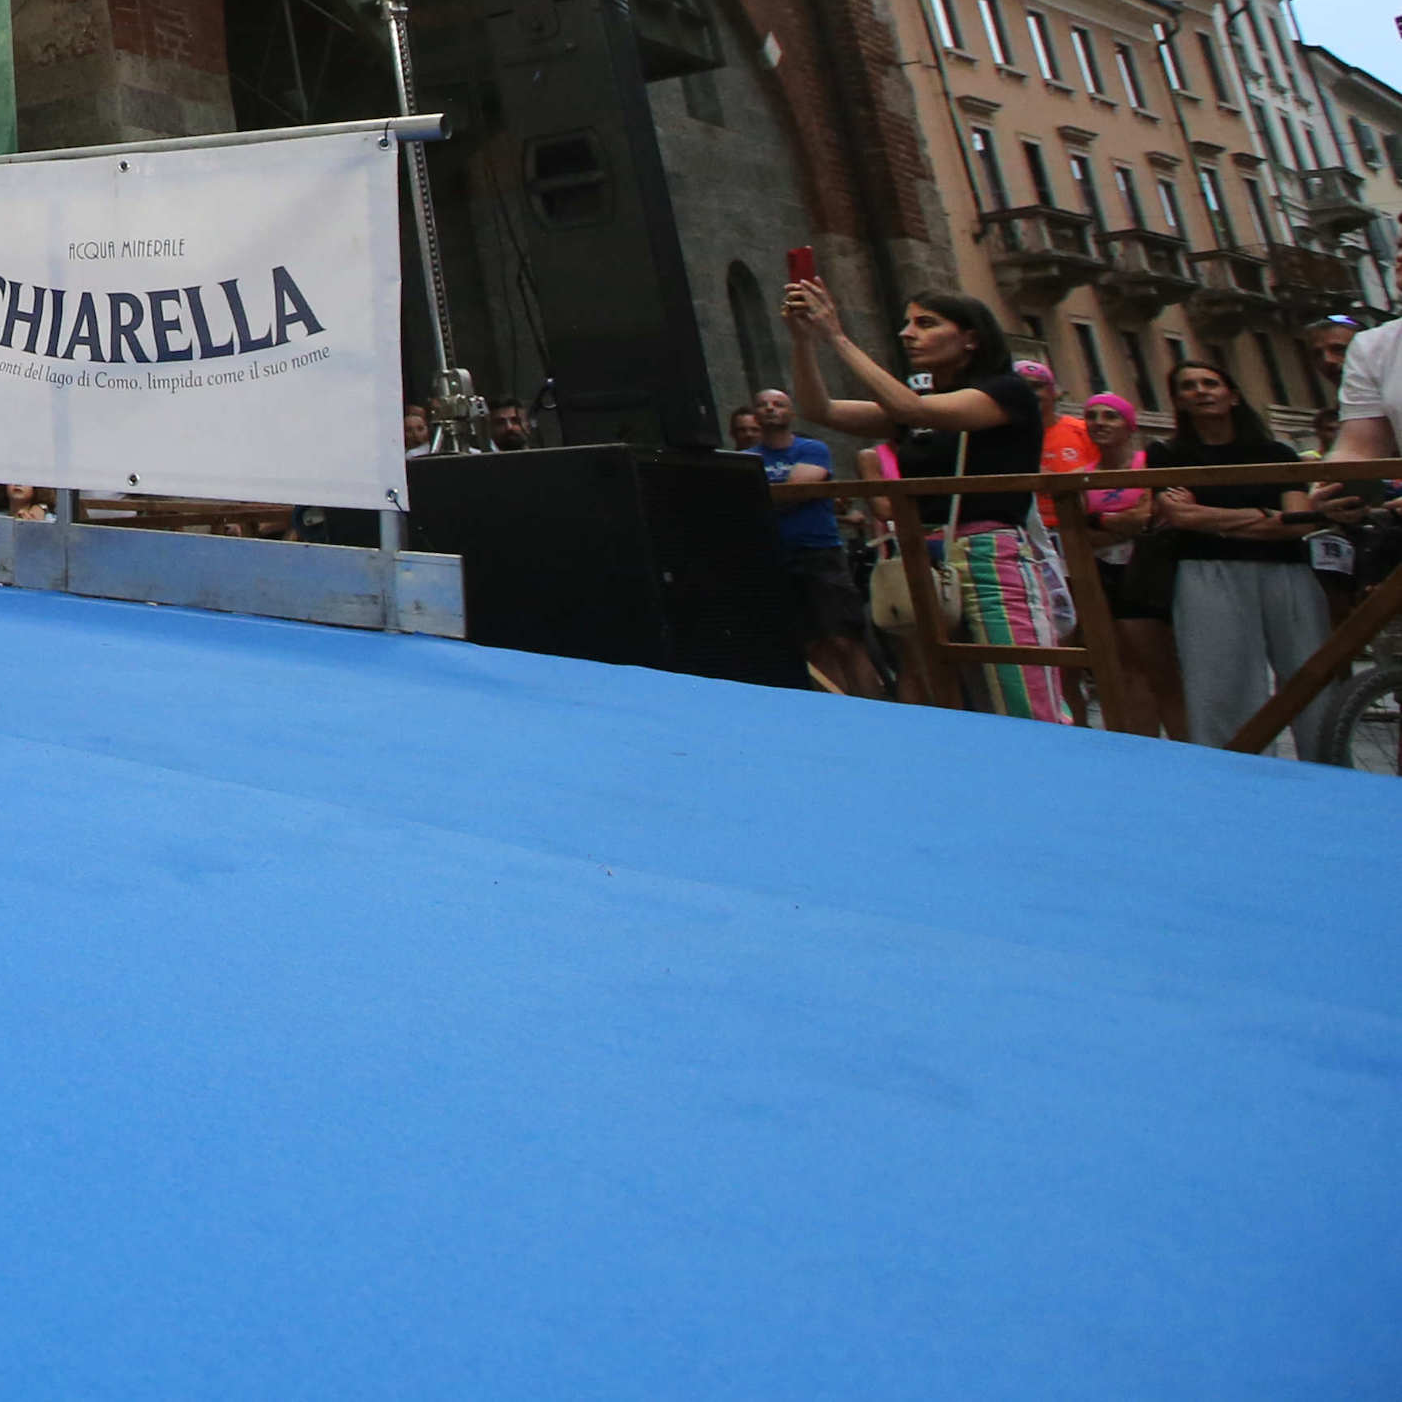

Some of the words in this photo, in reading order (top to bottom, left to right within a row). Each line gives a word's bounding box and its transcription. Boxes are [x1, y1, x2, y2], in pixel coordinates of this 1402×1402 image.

[68, 242, 116, 261] ACQUA
[121, 238, 186, 259] MINERALE
[24, 362, 44, 382] del
[44, 368, 74, 390] lago
[76, 369, 91, 389] di
[146, 370, 203, 395] limpida
[206, 370, 245, 386] come
[247, 364, 260, 382] il
[262, 360, 289, 378] suo
[291, 345, 331, 370] nome
